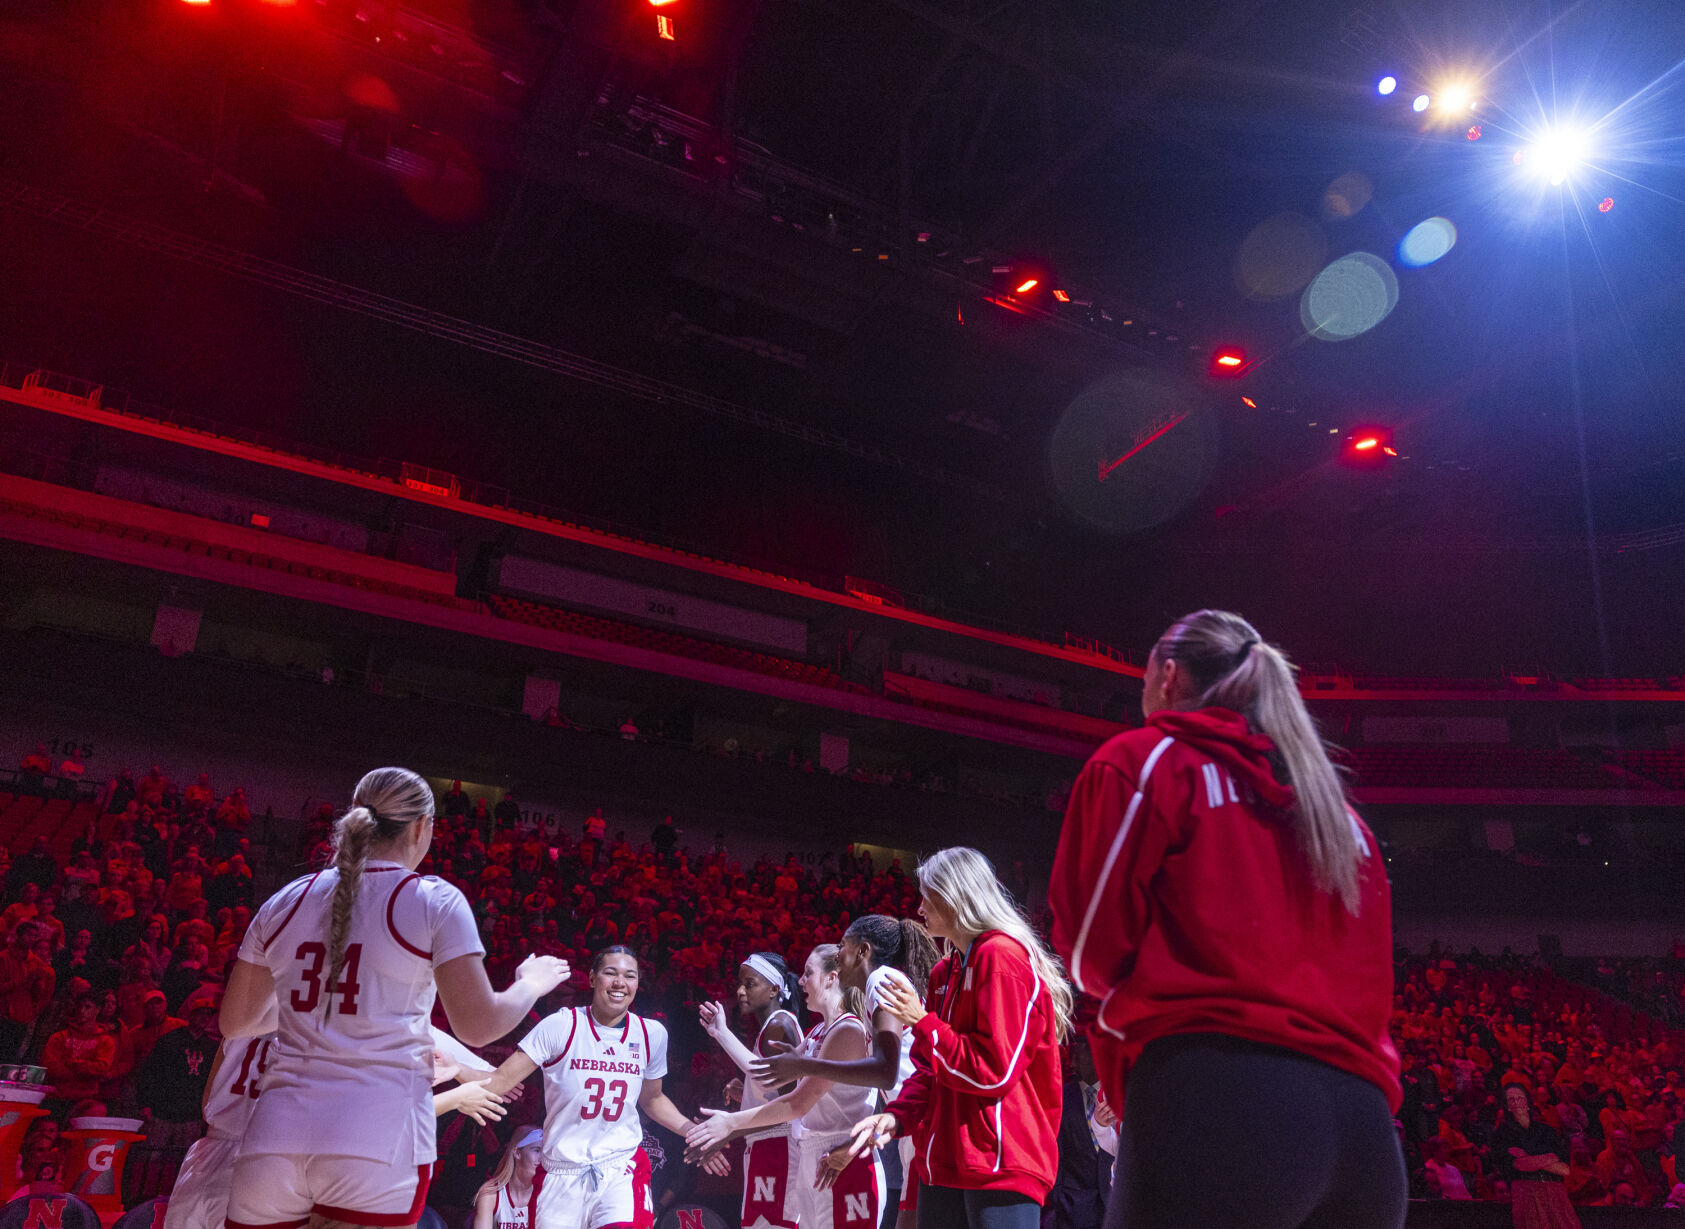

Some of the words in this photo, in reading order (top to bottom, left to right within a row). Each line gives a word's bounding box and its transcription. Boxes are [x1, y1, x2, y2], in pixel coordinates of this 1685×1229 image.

[648, 601, 675, 617] 204
[48, 739, 93, 758] 105
[520, 811, 555, 827] 106
[290, 942, 363, 1015] 34
[569, 1059, 641, 1075] NEBRASKA
[580, 1077, 629, 1122] 33
[87, 1144, 116, 1172] G
[752, 1176, 776, 1202] N
[22, 1199, 68, 1229] N
[676, 1208, 706, 1229] N
[844, 1192, 871, 1222] N
